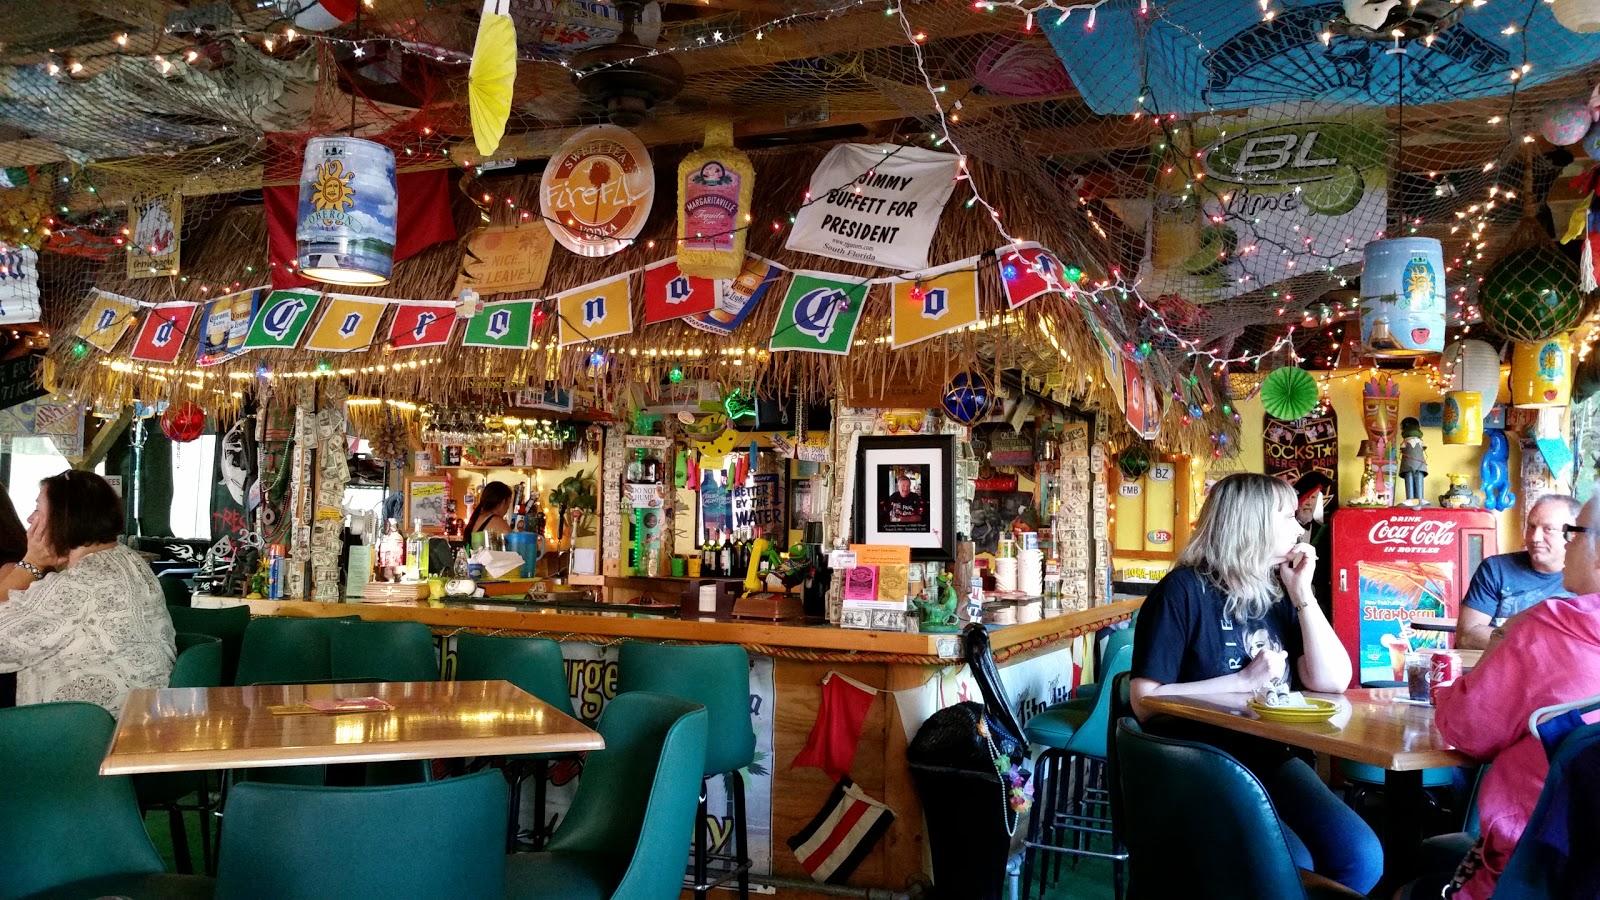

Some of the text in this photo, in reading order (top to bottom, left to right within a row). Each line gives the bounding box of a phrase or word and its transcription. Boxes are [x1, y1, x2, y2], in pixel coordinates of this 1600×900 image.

[1236, 131, 1338, 173] BL
[857, 171, 913, 191] JIMMY
[686, 196, 737, 212] MARGARITAVILLE
[826, 189, 918, 218] BUFFETT FOR
[308, 210, 353, 225] OBERON
[821, 214, 900, 244] PRESIDENT
[823, 242, 876, 261] South Florida
[1155, 468, 1169, 479] BZ
[734, 484, 769, 498] BETTER
[1122, 486, 1139, 495] FMB
[736, 498, 748, 509] BY
[750, 497, 769, 508] THE
[735, 509, 782, 528] WATER
[1368, 519, 1457, 546] Coca-Cola
